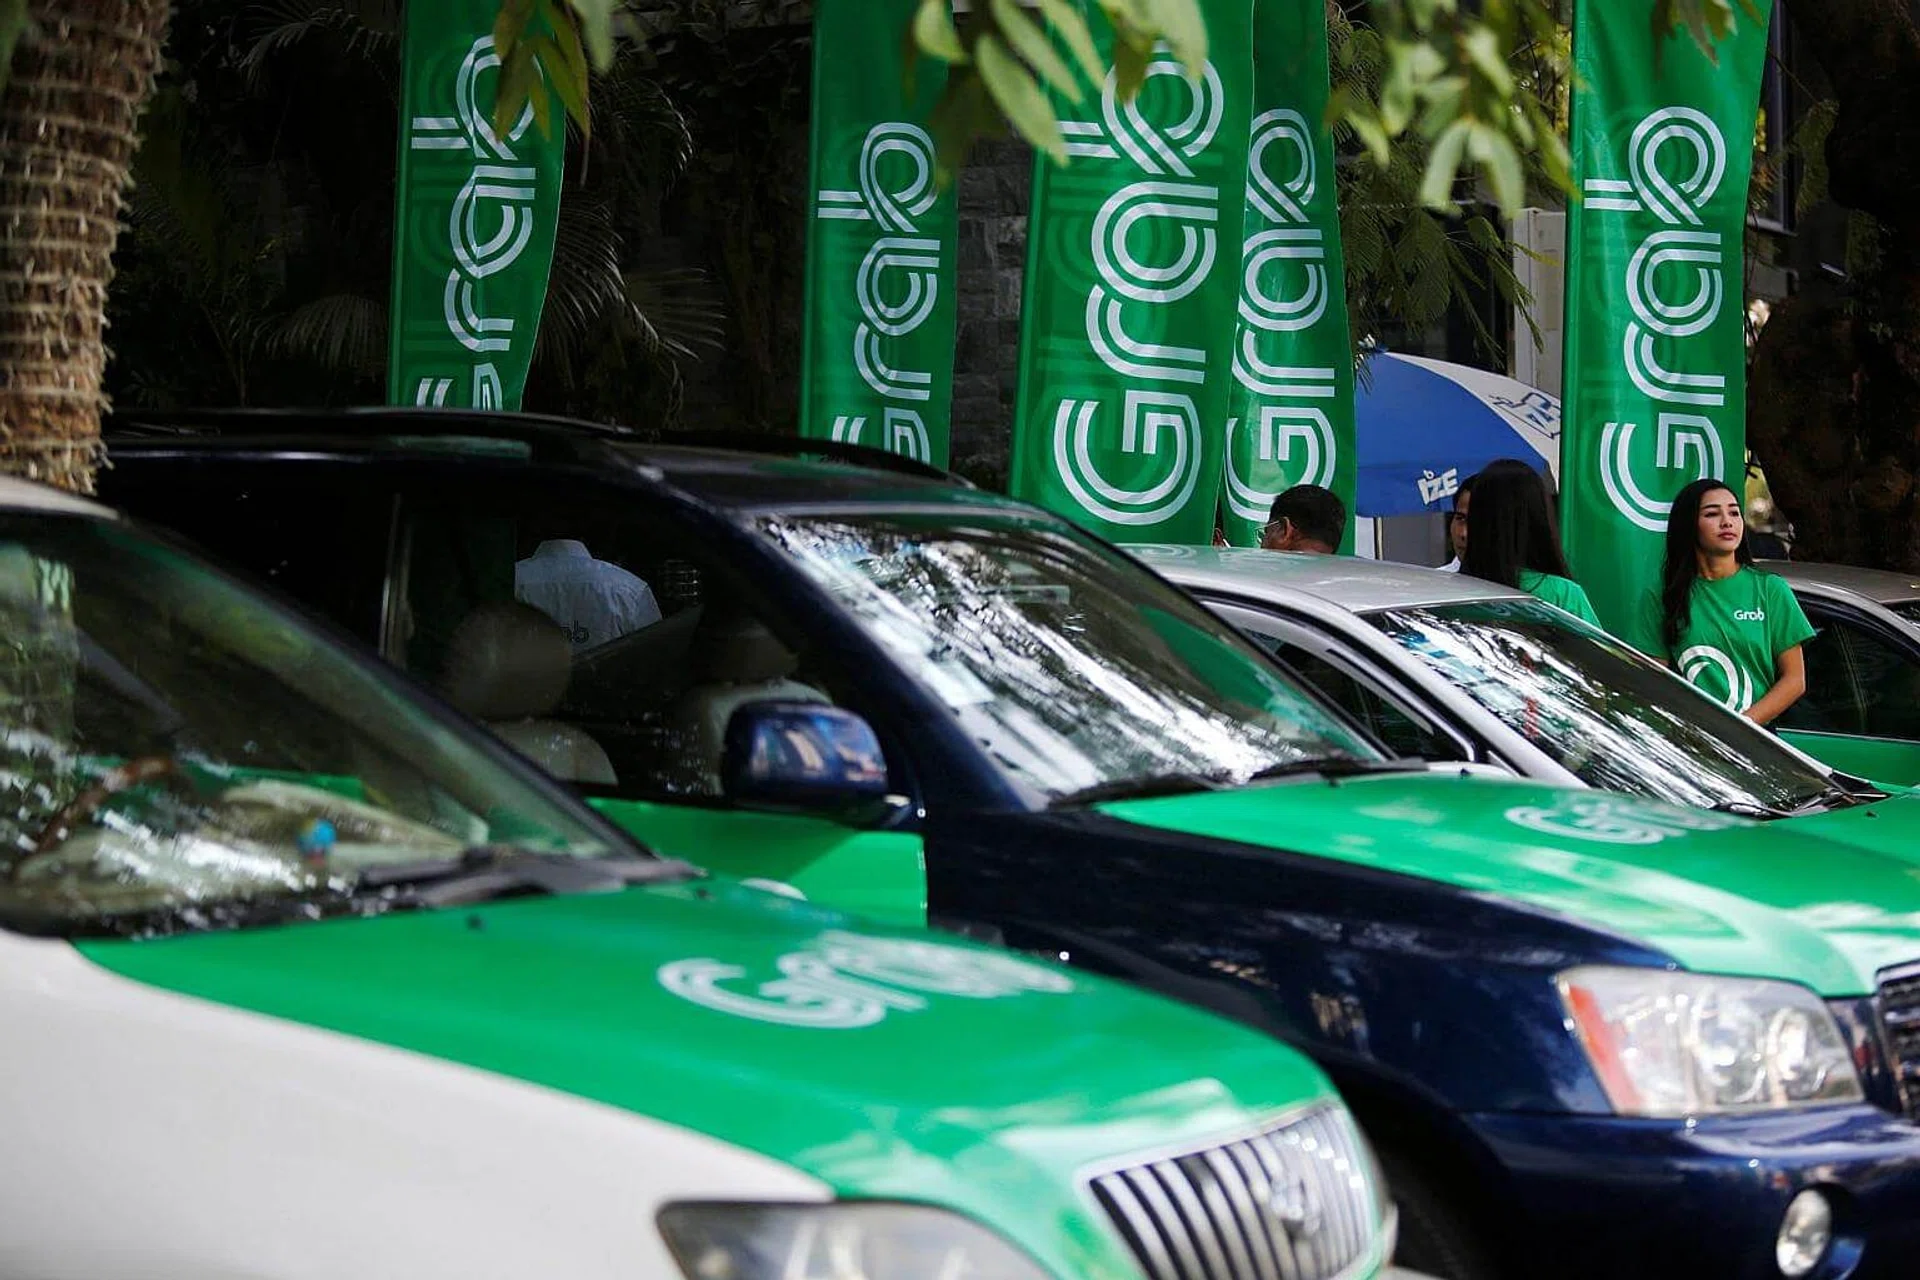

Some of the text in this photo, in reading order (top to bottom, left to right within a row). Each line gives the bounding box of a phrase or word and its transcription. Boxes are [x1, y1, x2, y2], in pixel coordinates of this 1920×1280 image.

[1054, 40, 1224, 525] Grab
[1226, 108, 1337, 522] Grab
[1584, 106, 1726, 532] Grab
[1734, 607, 1765, 621] Grab
